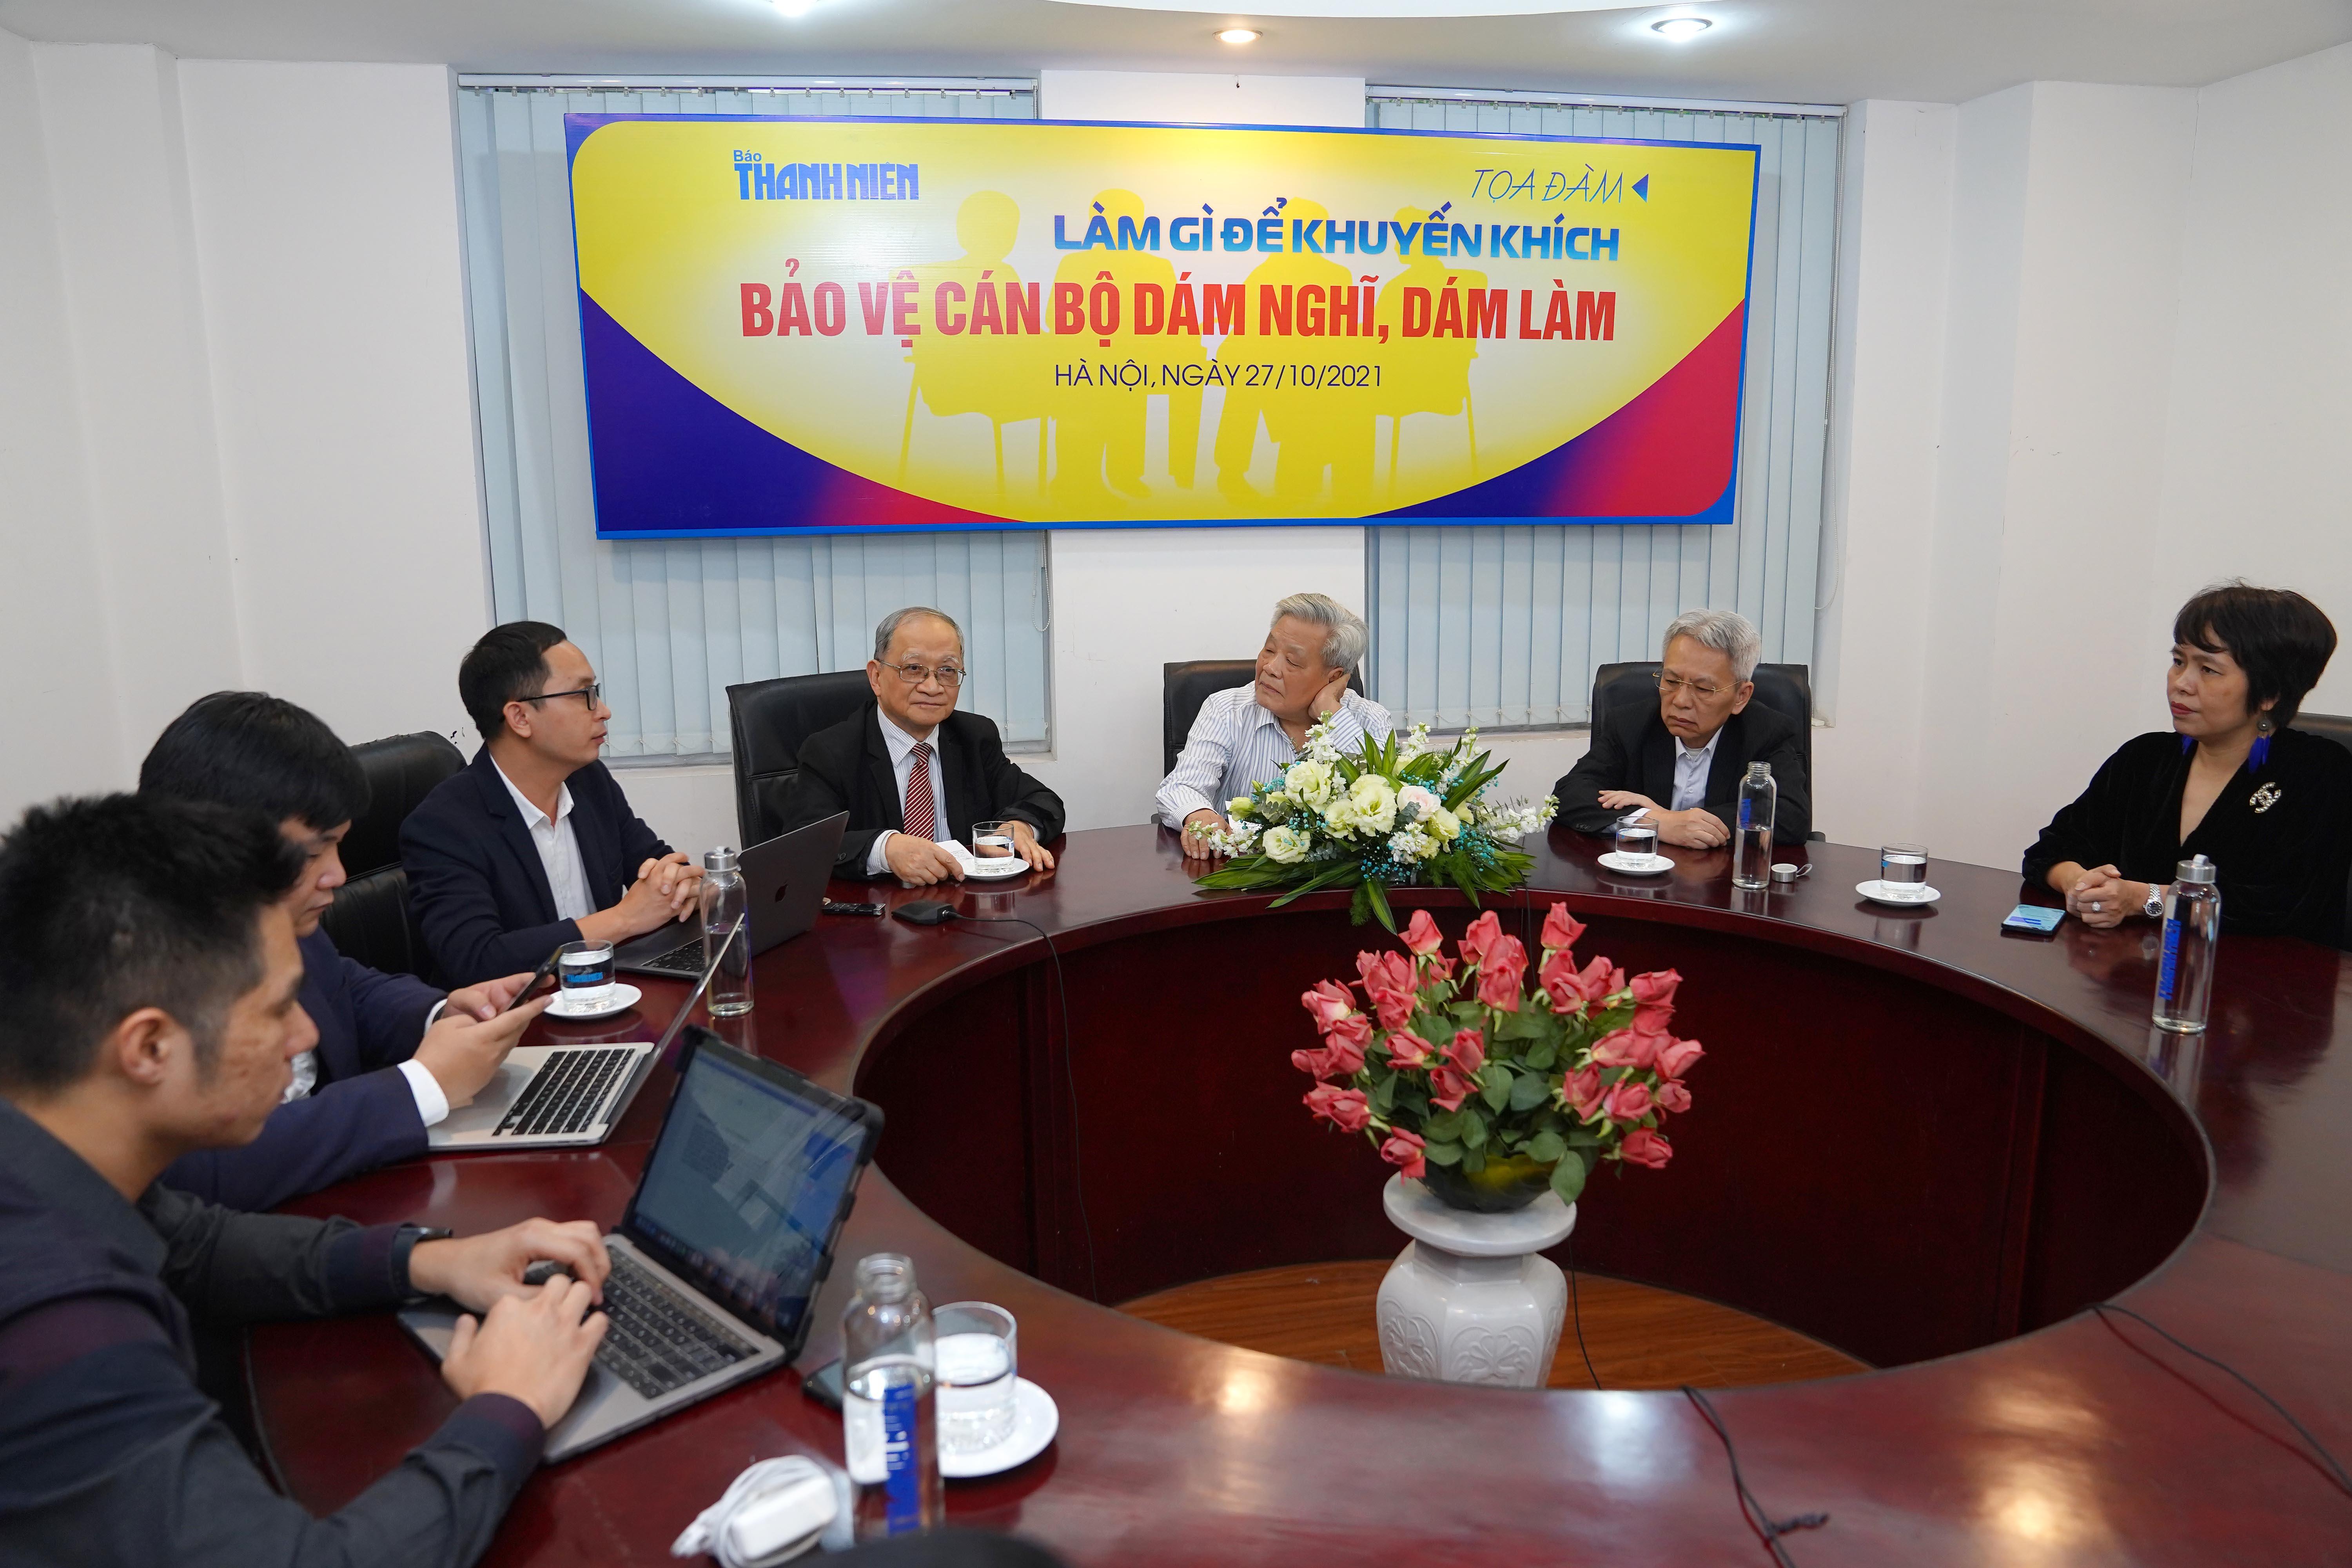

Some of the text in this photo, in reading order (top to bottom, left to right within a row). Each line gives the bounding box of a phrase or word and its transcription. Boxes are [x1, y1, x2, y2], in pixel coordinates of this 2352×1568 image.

[733, 149, 762, 162] Báo
[734, 163, 842, 200] THANH
[1472, 163, 1622, 203] TỌA ĐÀM
[1054, 197, 1620, 261] LÀM GÌ ĐỂ KHUYẾN KHÍCH
[740, 258, 1616, 348] BẢO VỆ CÁN BỘ DÁM NGHĨ, DÁM LÀM
[1055, 358, 1381, 392] HÀ NỘI, NGÀY 27/10/2021
